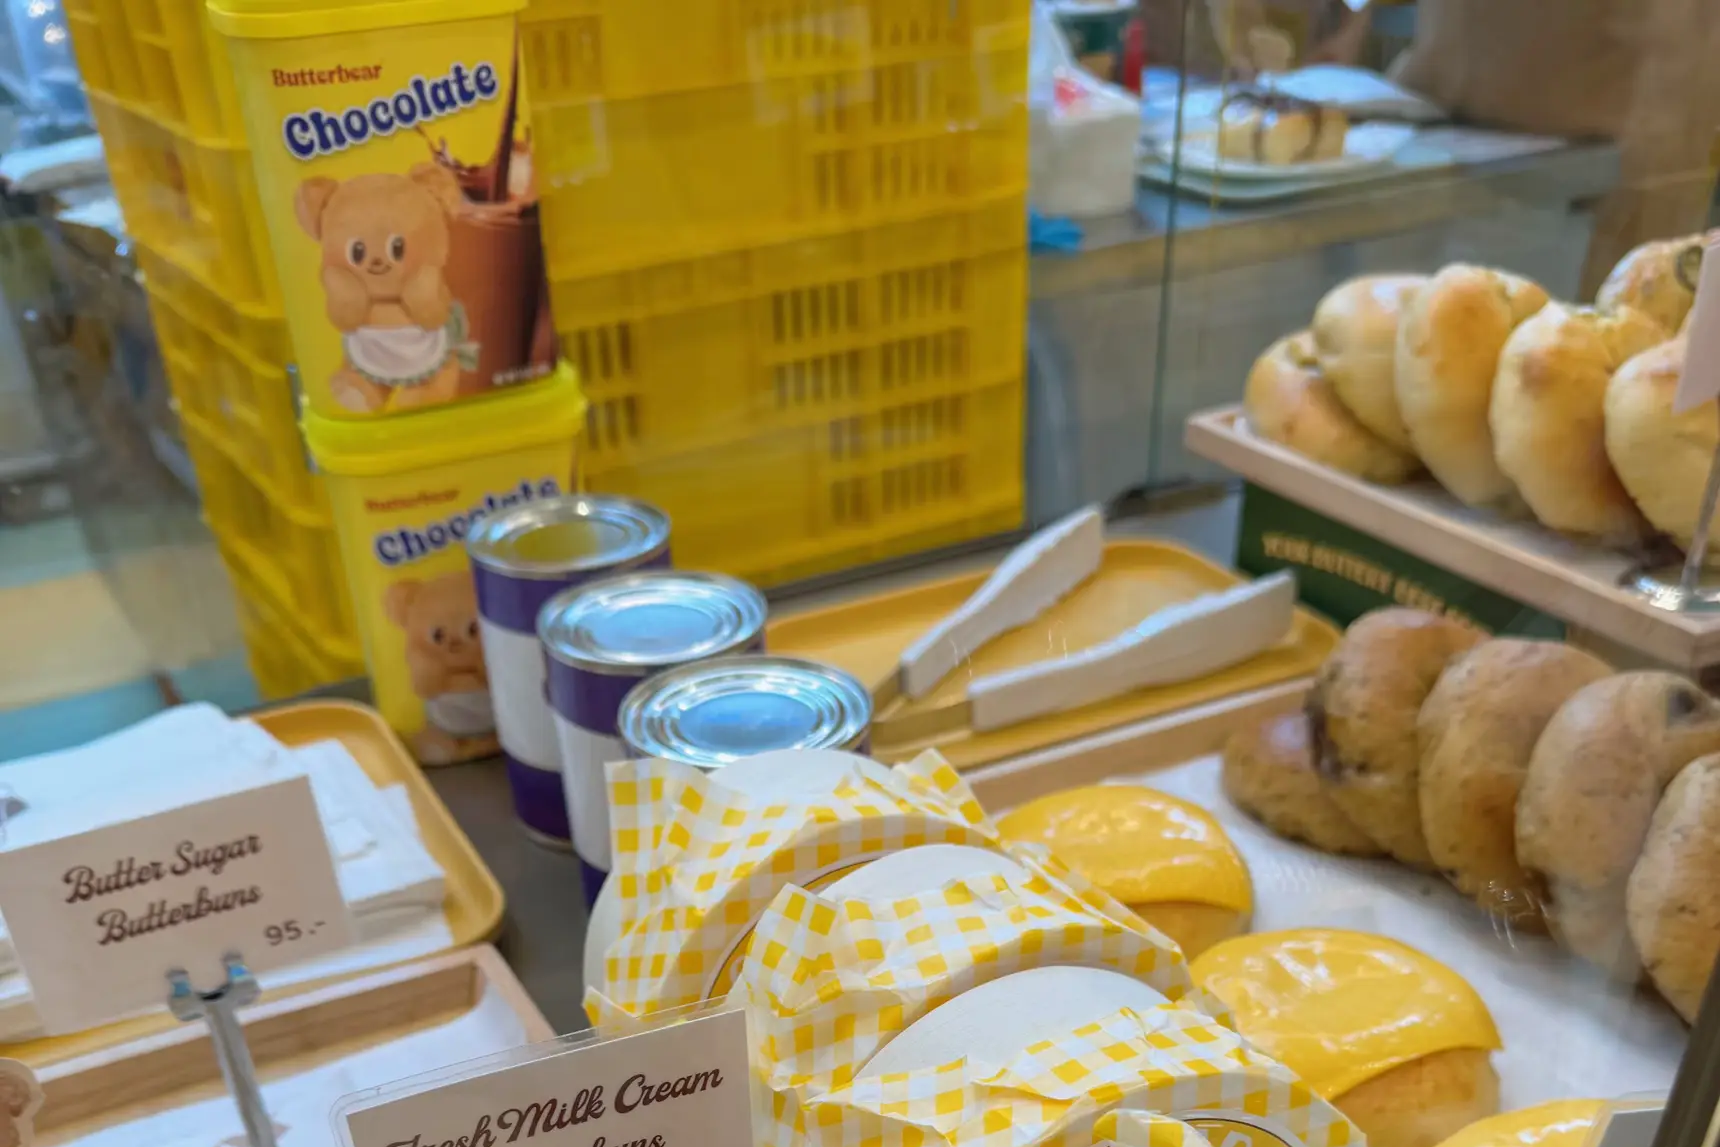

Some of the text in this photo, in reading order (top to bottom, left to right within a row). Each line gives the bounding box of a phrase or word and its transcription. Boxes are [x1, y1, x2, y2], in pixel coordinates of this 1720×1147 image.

[272, 63, 382, 88] Butterbear
[283, 62, 498, 158] Chocolate
[62, 834, 263, 904] Butter Sugar
[96, 886, 263, 946] Butterbuns
[264, 919, 326, 946] 95.-
[496, 1085, 606, 1143] Milk
[614, 1068, 724, 1115] Cream
